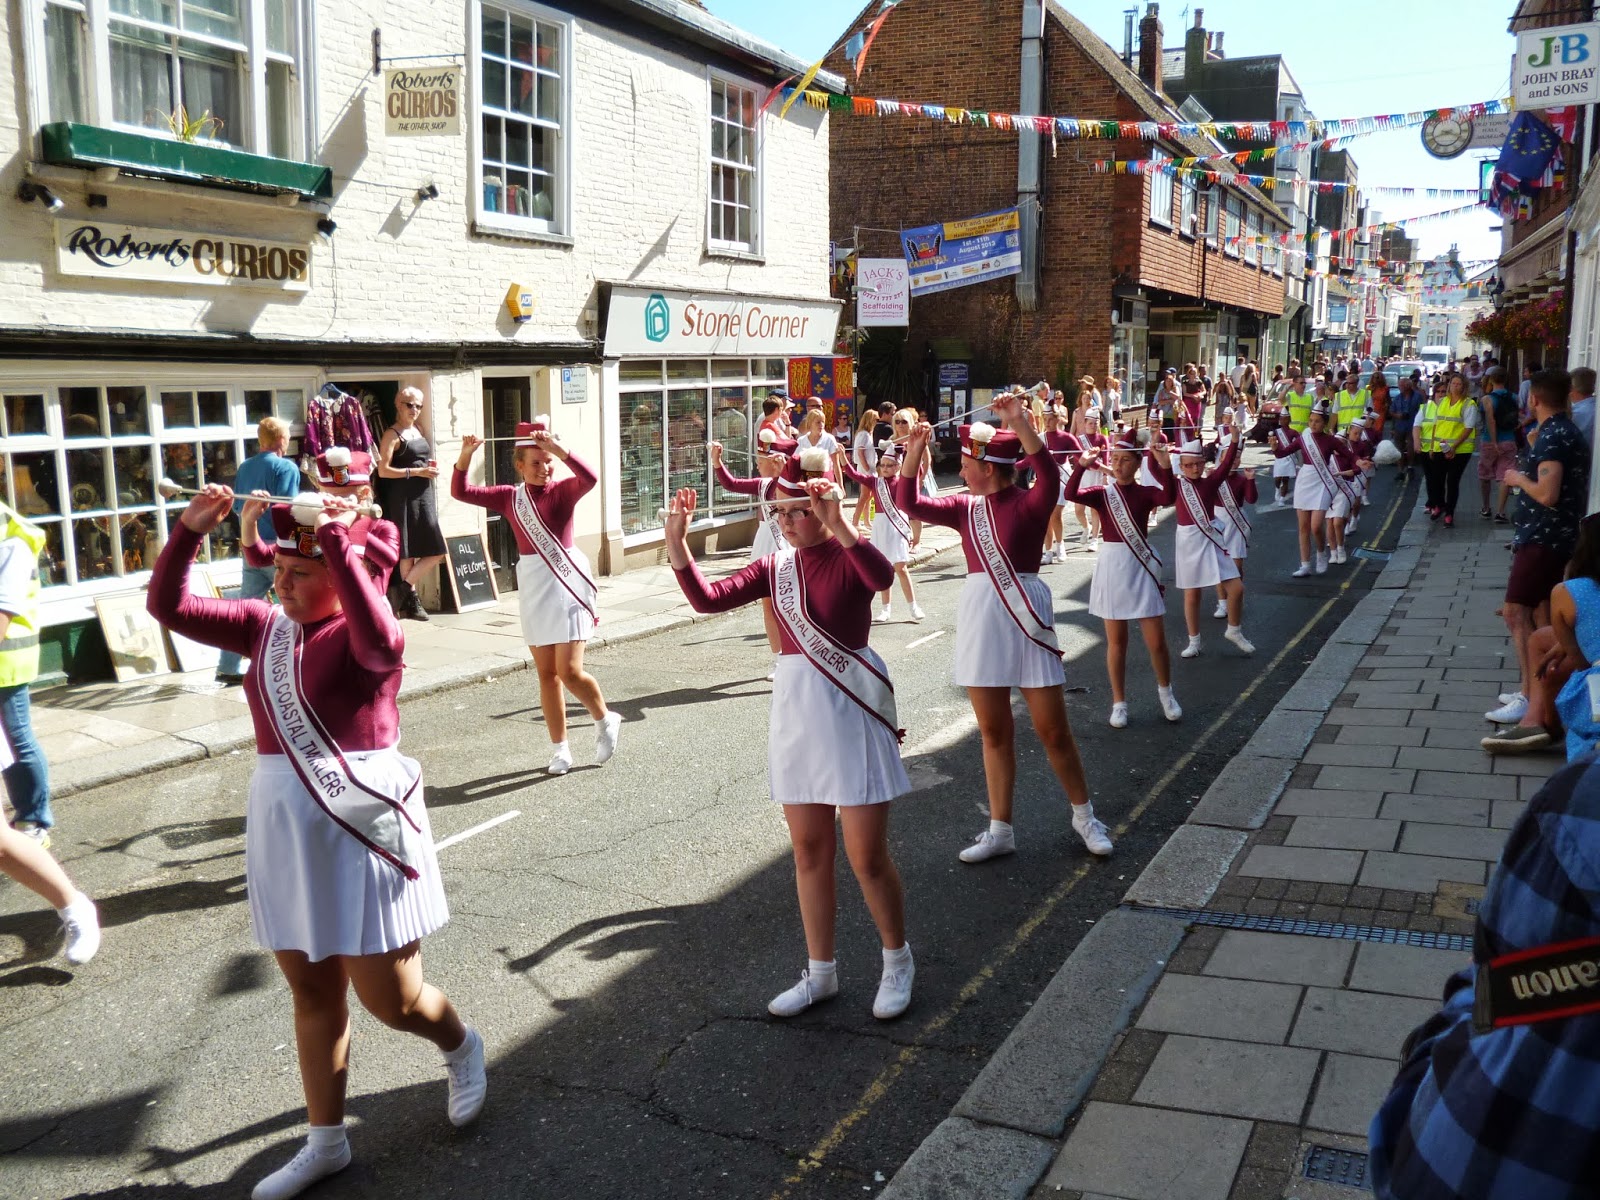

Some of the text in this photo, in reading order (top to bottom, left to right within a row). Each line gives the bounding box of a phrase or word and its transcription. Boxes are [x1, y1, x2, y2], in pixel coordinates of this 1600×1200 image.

[391, 71, 454, 91] Roberts
[1522, 67, 1596, 85] JOHN BRAY
[1528, 82, 1588, 99] and SONS
[398, 121, 447, 132] THE OTHER SHOP
[969, 219, 982, 227] and
[983, 216, 998, 224] local
[65, 225, 191, 268] Roberts
[959, 244, 980, 254] August
[863, 303, 904, 311] Scaffolding
[681, 303, 809, 339] Stone Corner
[1118, 513, 1135, 542] COASTAL
[516, 498, 572, 578] HASTINGS COASTAL TWIRLERS
[458, 543, 475, 554] ALL
[455, 560, 487, 578] WELCOME
[978, 529, 998, 562] COASTAL
[991, 557, 1014, 591] TWIRLERS
[780, 593, 809, 638] COASTAL
[806, 632, 850, 674] TWIRLERS
[271, 627, 346, 799] HASTINGS COASTAL TWIRLERS
[1511, 960, 1600, 1000] anon
